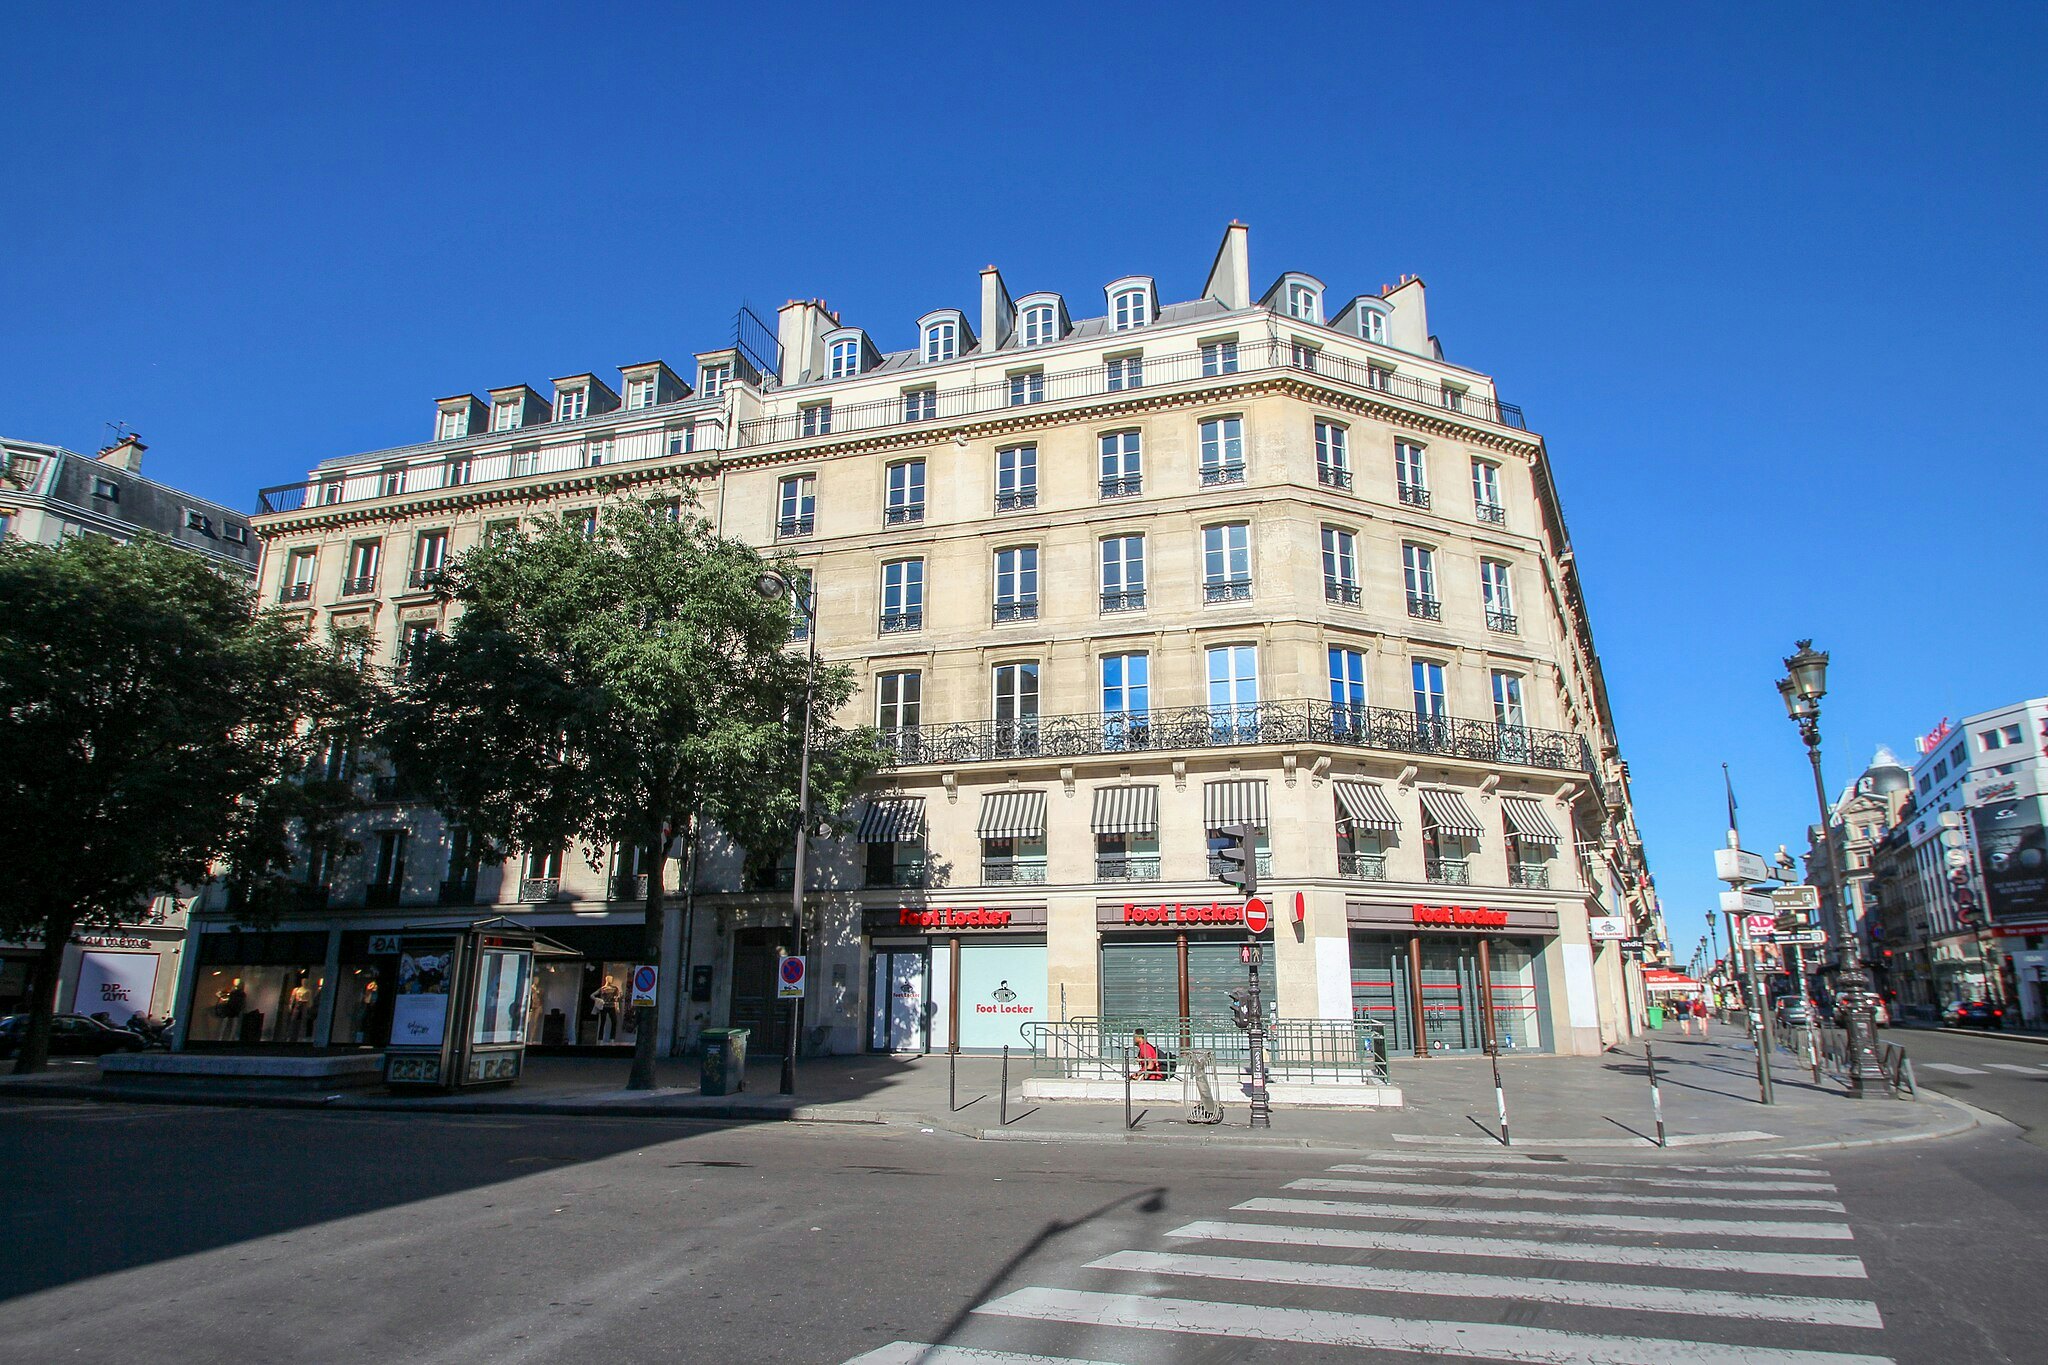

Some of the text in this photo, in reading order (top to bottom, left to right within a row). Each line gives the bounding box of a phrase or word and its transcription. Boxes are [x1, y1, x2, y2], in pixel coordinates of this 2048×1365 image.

[899, 907, 1011, 926] Foot Locker
[1123, 903, 1169, 922] Foot
[1412, 904, 1508, 925] Foot Locker
[102, 992, 129, 1002] am
[976, 1004, 1034, 1014] Foot Locker
